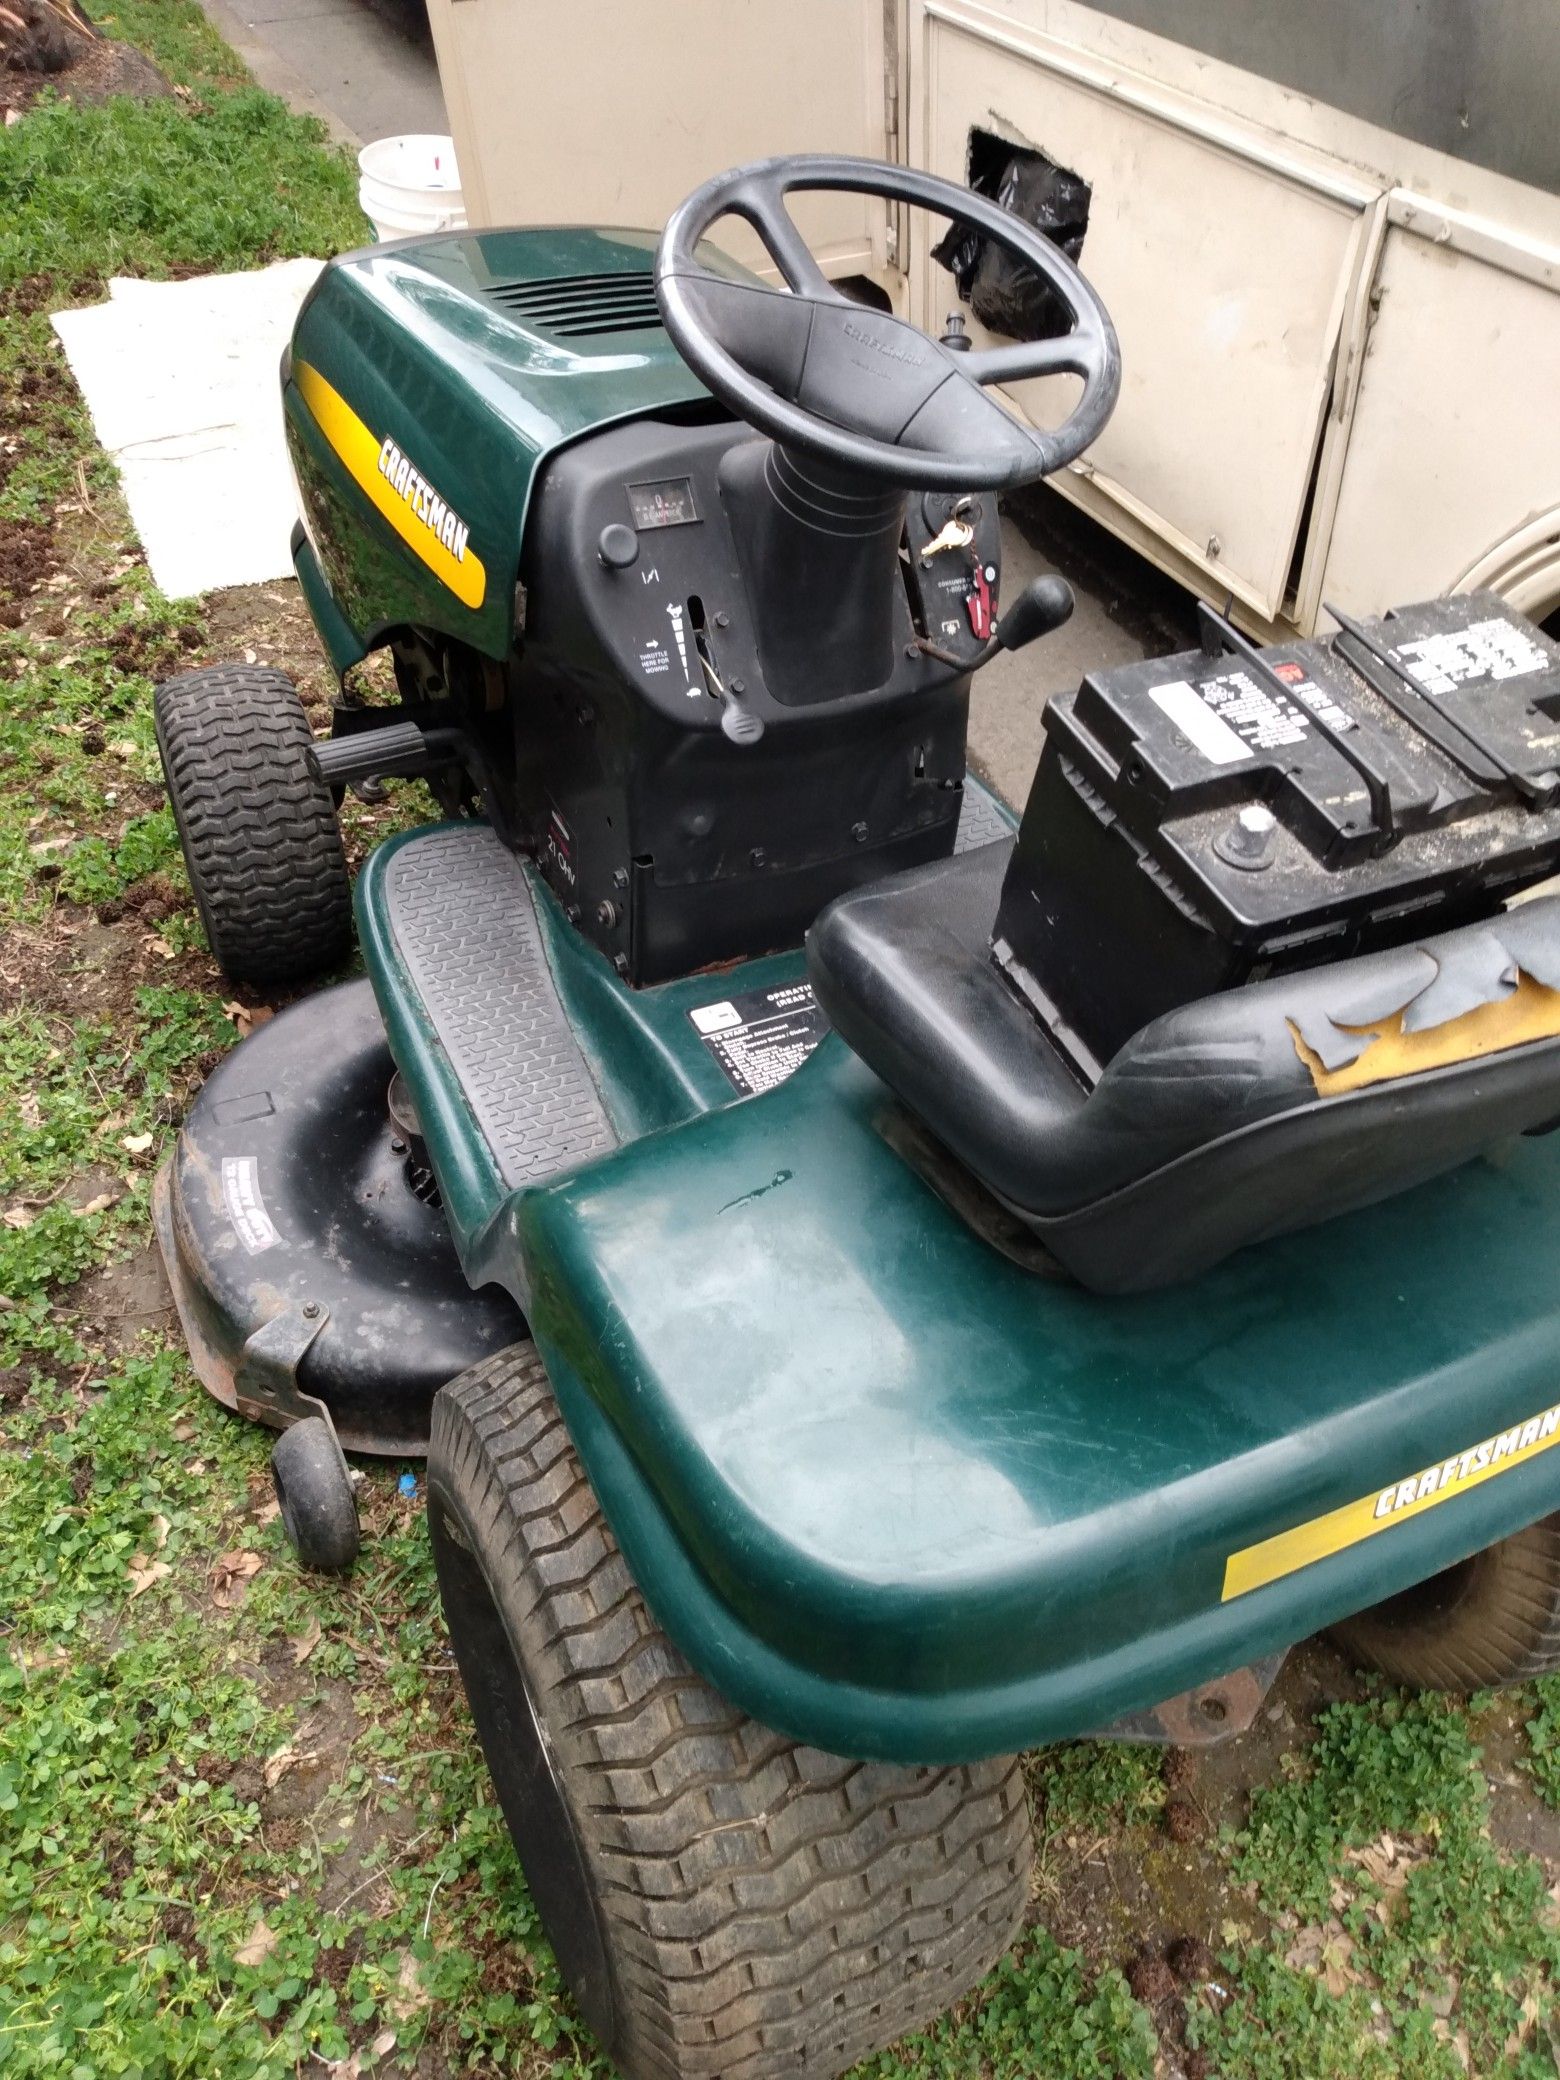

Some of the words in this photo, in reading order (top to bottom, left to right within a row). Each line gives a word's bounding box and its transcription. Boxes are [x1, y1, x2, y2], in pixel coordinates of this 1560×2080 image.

[378, 438, 469, 563] CRAFTSMAN
[639, 650, 668, 660] THROTTLE
[641, 660, 657, 668] HERE
[1374, 1405, 1560, 1519] CRAFTSMAN
